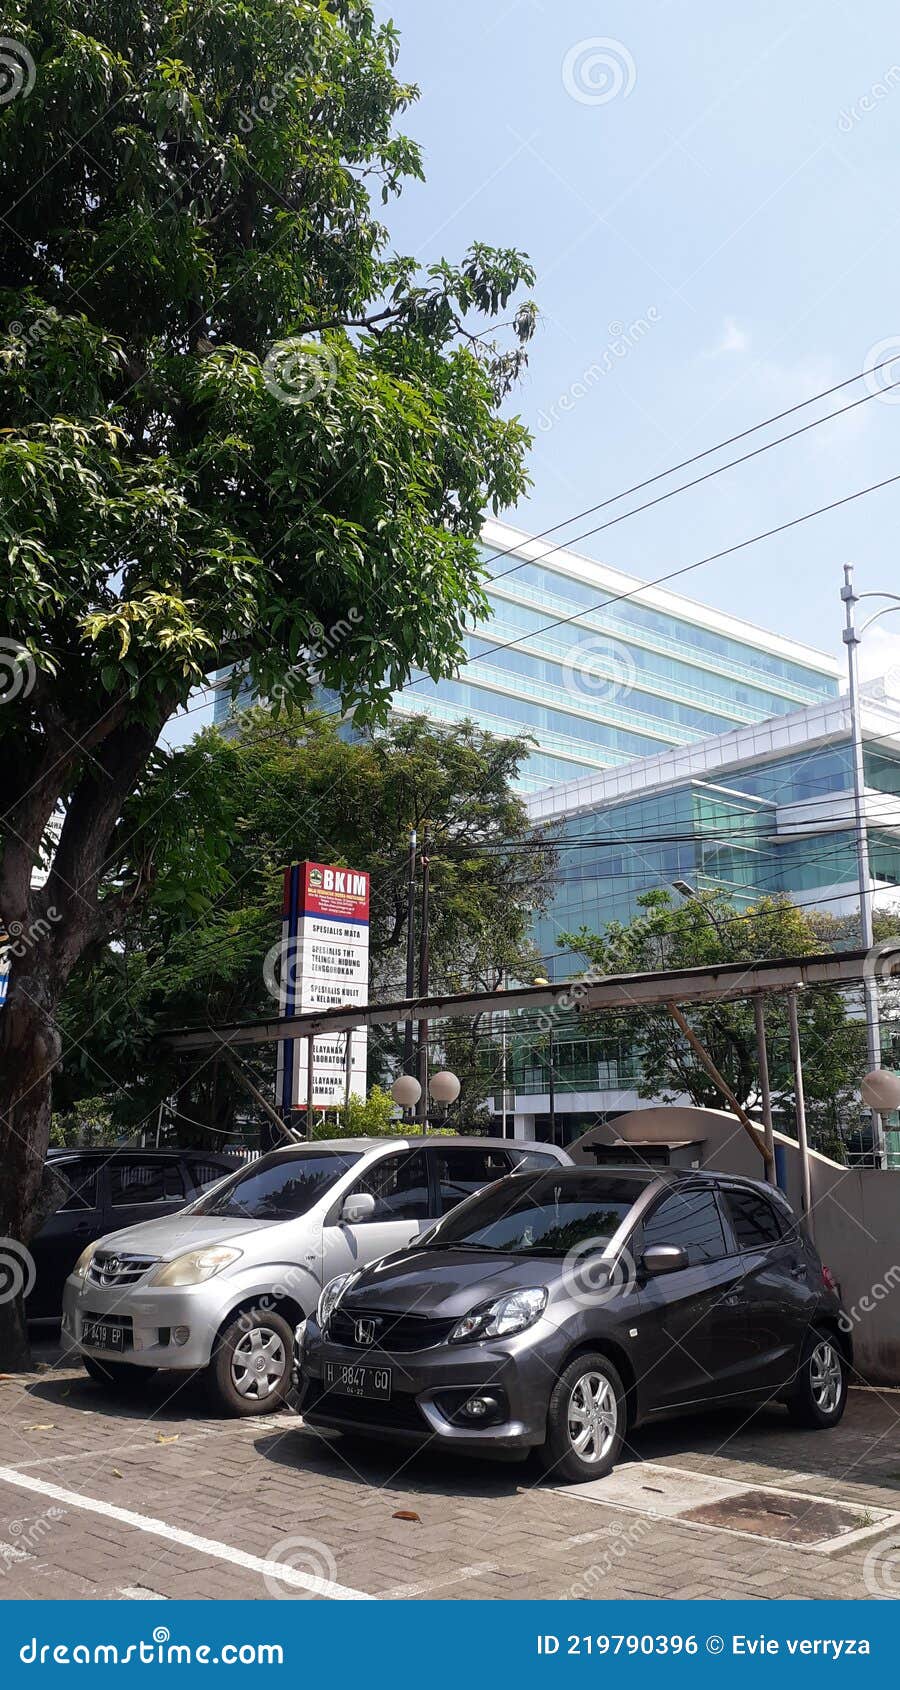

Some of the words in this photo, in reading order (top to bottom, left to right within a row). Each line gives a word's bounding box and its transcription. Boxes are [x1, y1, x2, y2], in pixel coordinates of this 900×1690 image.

[323, 869, 366, 896] BKIM
[312, 924, 343, 936] SPESIALIS
[344, 929, 361, 938] MATA
[311, 945, 341, 956] SPESIALIS
[343, 949, 354, 958] THT
[338, 958, 361, 967] HIDUNG
[341, 988, 359, 997] KULIT
[316, 994, 342, 1004] KELAMIN
[312, 1045, 343, 1054] ELAYANAN
[312, 1076, 343, 1085] ELAYANAN
[111, 1328, 121, 1343] EP
[327, 1364, 334, 1382] H
[342, 1366, 366, 1386] 8847
